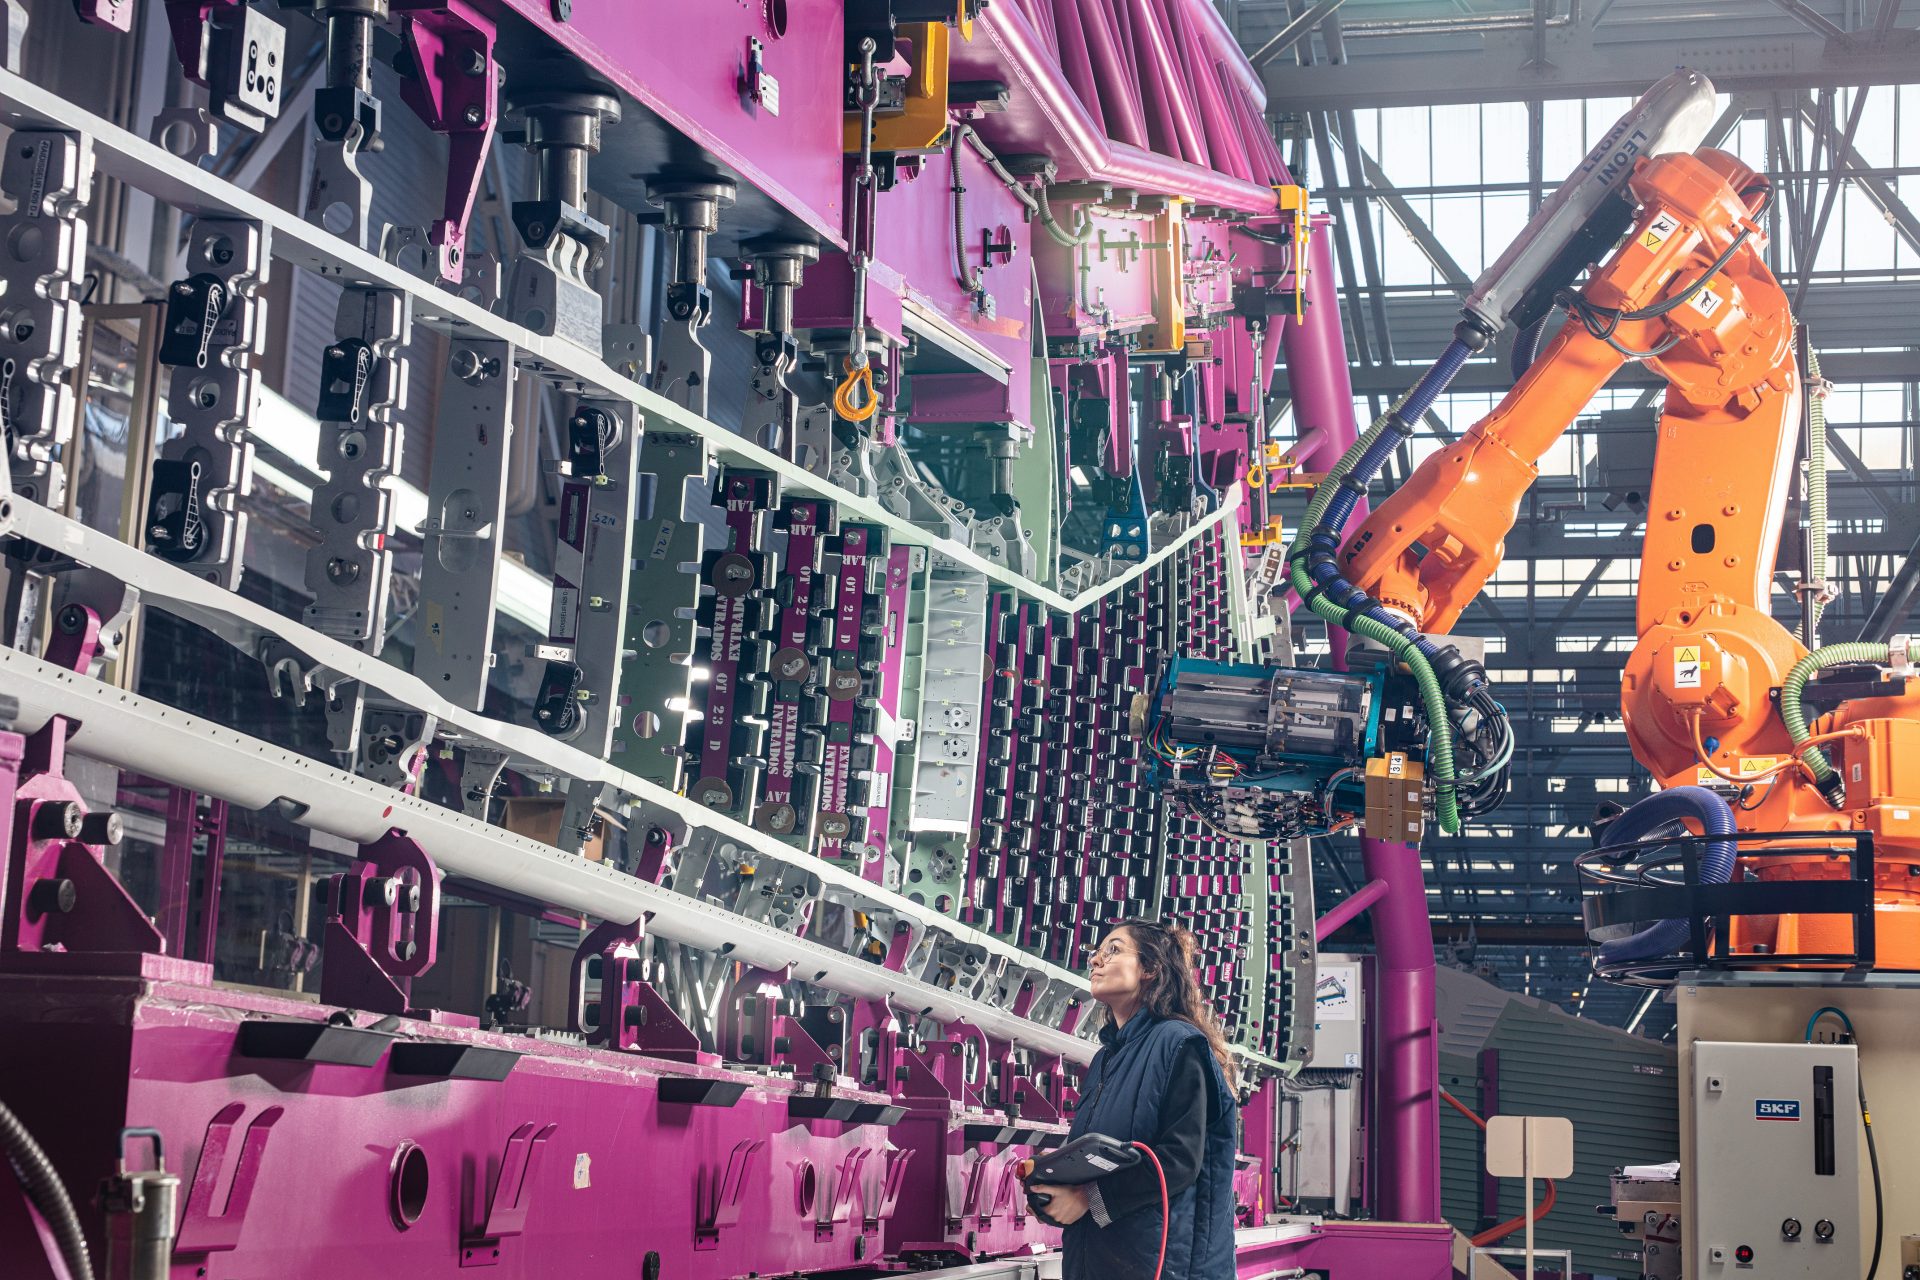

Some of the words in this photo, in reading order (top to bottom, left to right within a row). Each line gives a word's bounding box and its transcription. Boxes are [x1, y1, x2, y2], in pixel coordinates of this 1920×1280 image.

[1582, 121, 1629, 173] LEONI
[1596, 129, 1648, 186] LEONI
[726, 499, 756, 512] LAR
[790, 524, 817, 536] LAR
[1345, 531, 1374, 565] ABB
[842, 554, 867, 566] LAR
[799, 565, 811, 585] OT
[845, 576, 857, 595] OT
[792, 632, 806, 644] D
[840, 634, 851, 644] D
[715, 672, 728, 694] OT
[709, 740, 721, 751] D
[767, 703, 785, 775] INTRADOS
[782, 705, 799, 779] EXTRADOS
[821, 744, 837, 812] INTRADOS
[835, 745, 850, 813] EXTRADOS
[765, 790, 791, 804] LAV
[1759, 1103, 1797, 1114] SKF
